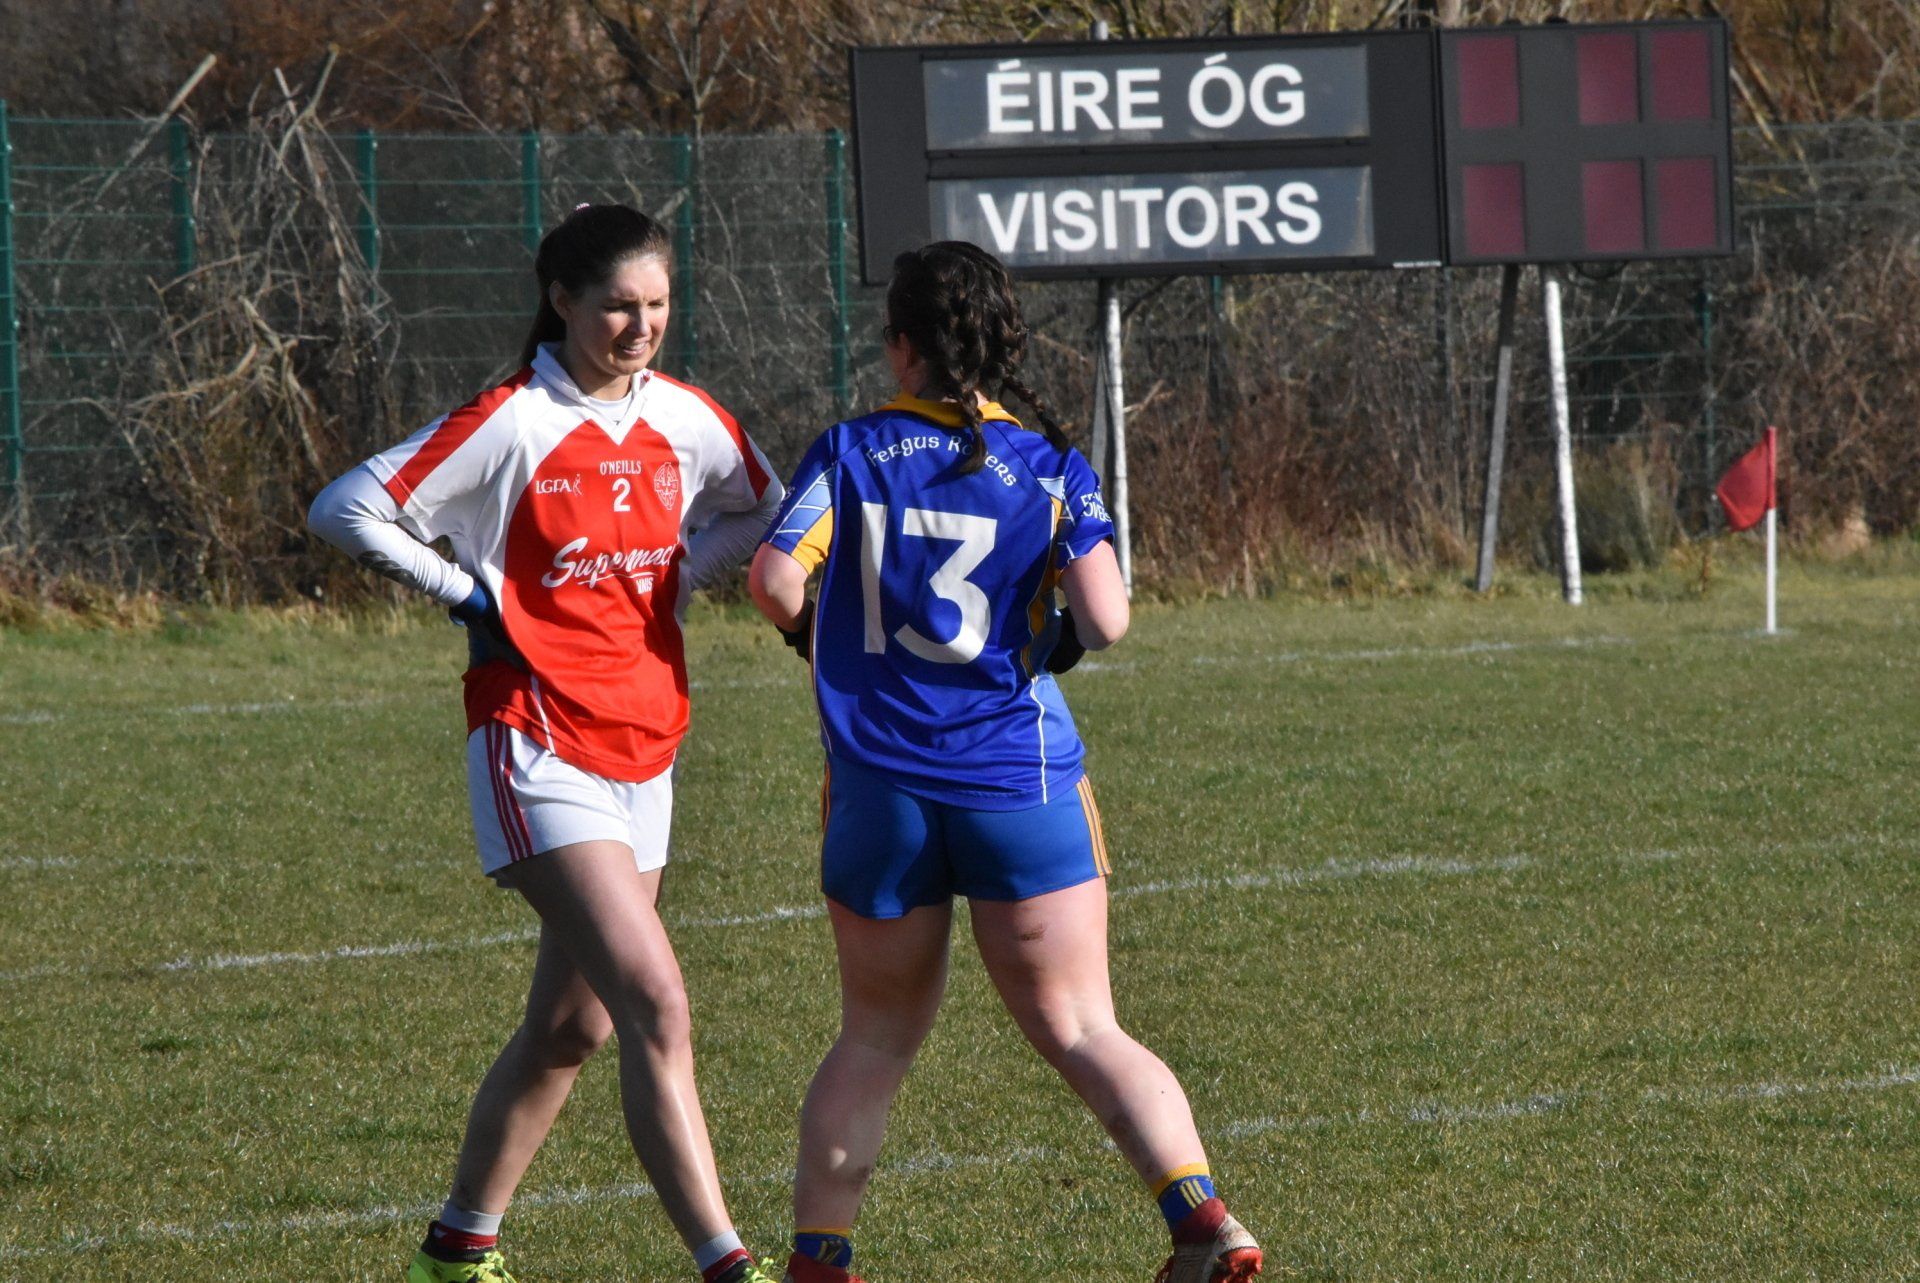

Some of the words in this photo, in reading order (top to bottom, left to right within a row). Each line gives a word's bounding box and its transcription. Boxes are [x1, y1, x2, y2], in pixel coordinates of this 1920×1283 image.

[986, 58, 1164, 134] ÉIRE
[1187, 52, 1306, 129] ÓG
[977, 181, 1323, 254] VISITORS
[535, 478, 572, 495] LGFA
[600, 460, 642, 476] O'NEILLS
[865, 436, 940, 467] Fergus
[947, 434, 1017, 487] Roers
[611, 477, 631, 512] 2
[860, 501, 998, 665] 13
